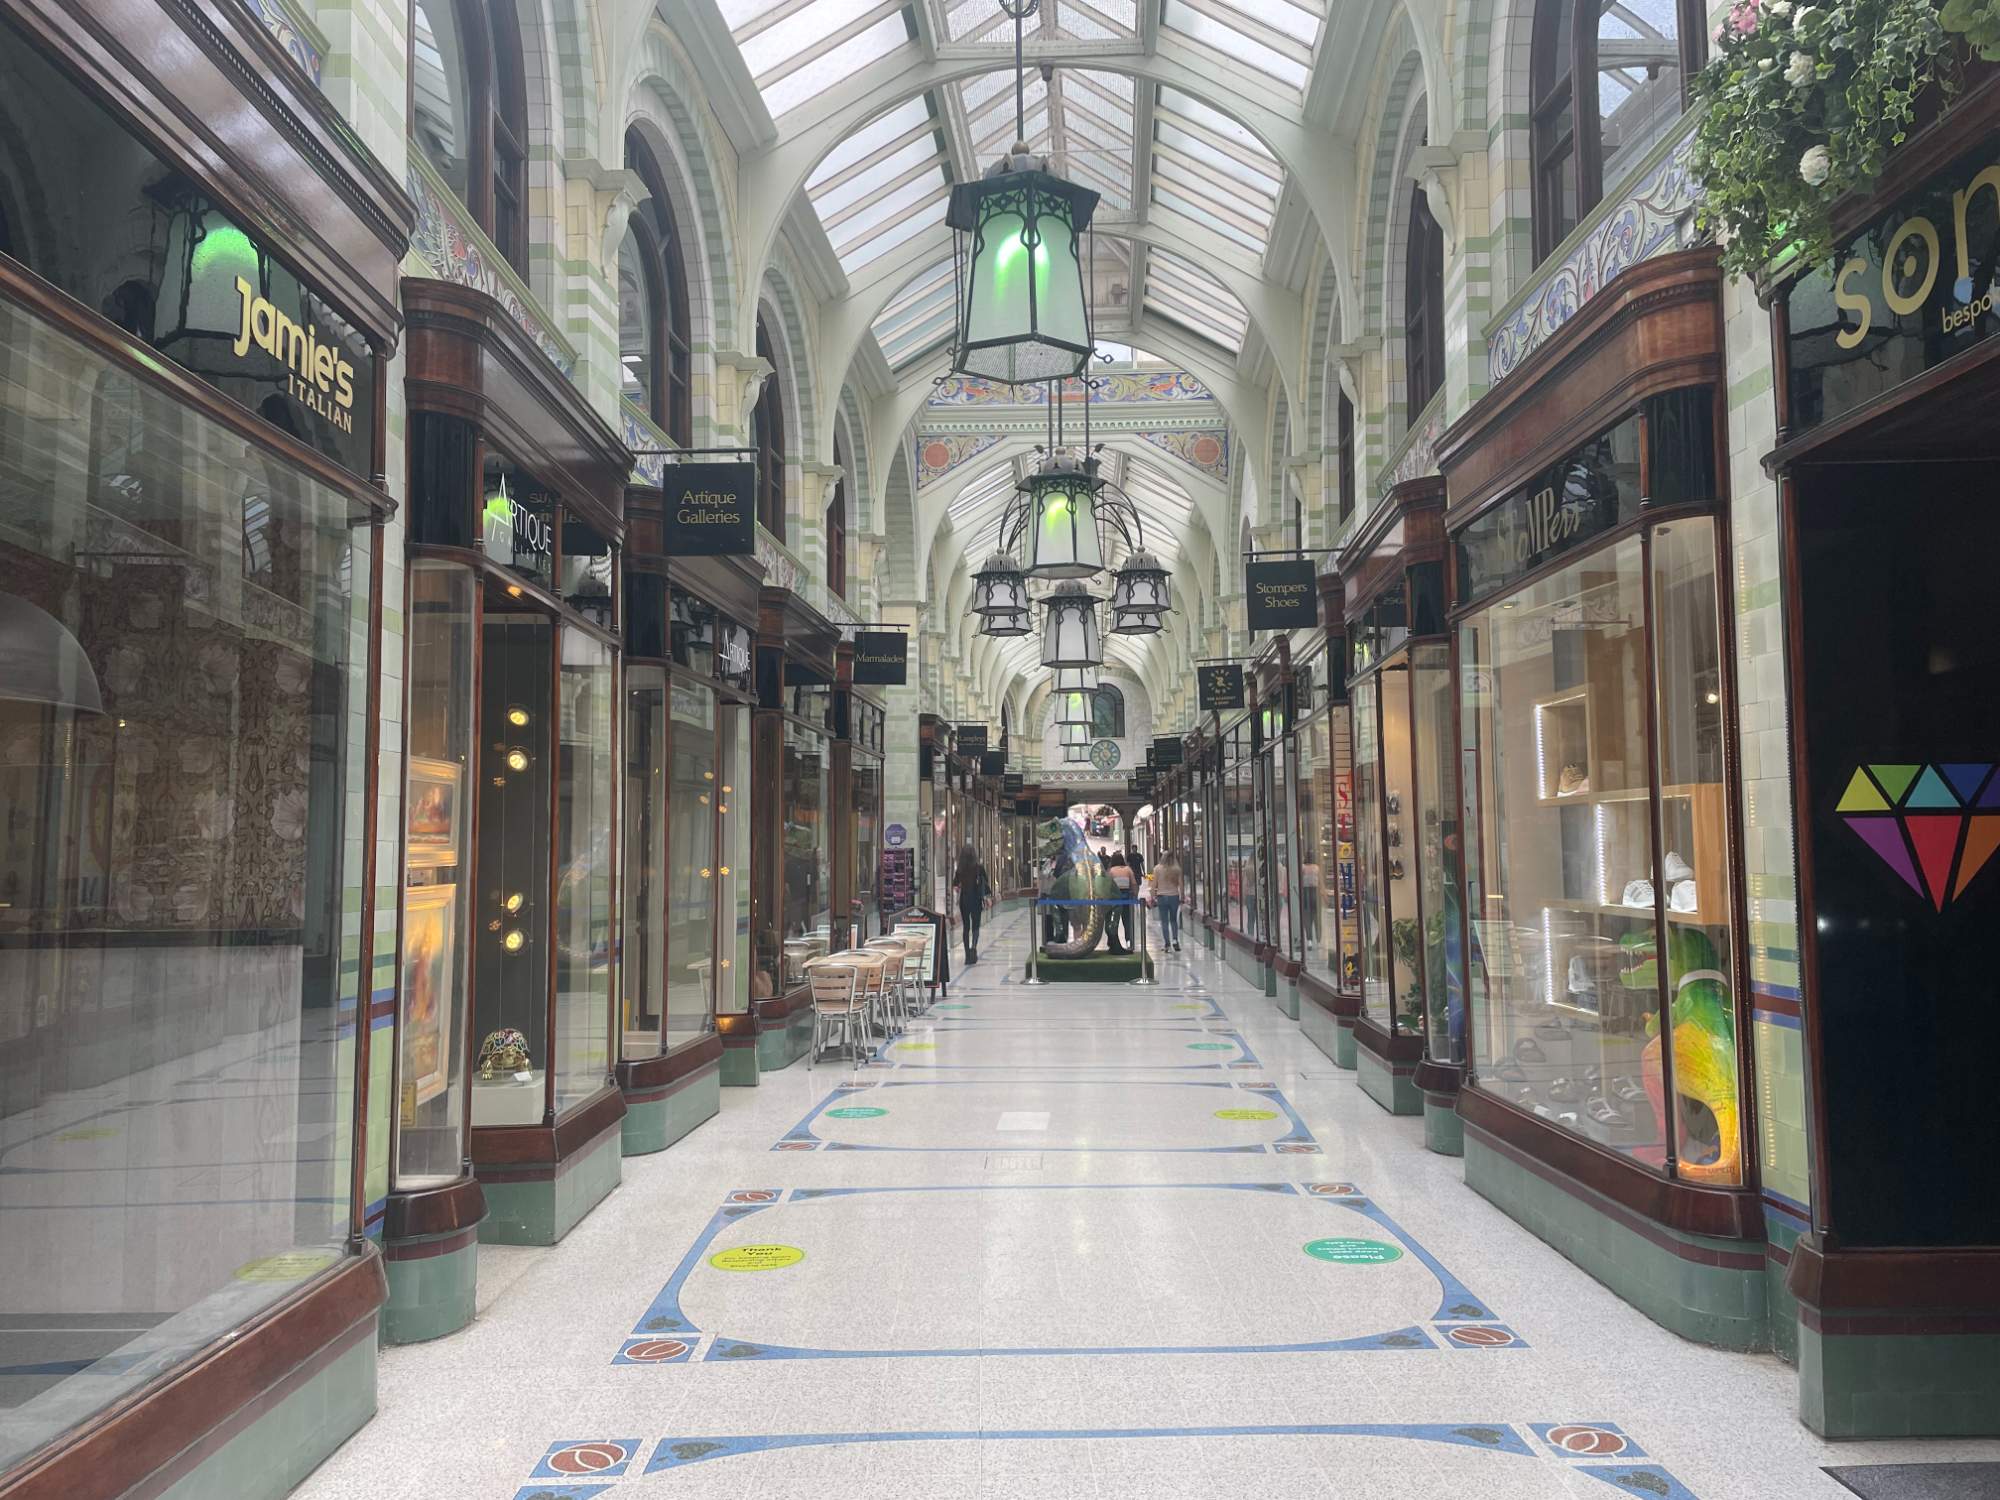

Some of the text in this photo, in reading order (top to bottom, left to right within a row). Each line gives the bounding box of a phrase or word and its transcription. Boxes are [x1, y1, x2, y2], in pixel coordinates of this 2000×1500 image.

[1941, 279, 2000, 334] bespo
[233, 275, 354, 409] Jamie's
[288, 373, 352, 434] ITALIAN
[680, 490, 737, 509] Artique
[677, 509, 741, 524] Galleries
[1255, 582, 1308, 597] Stompers
[1264, 596, 1301, 608] Shoes
